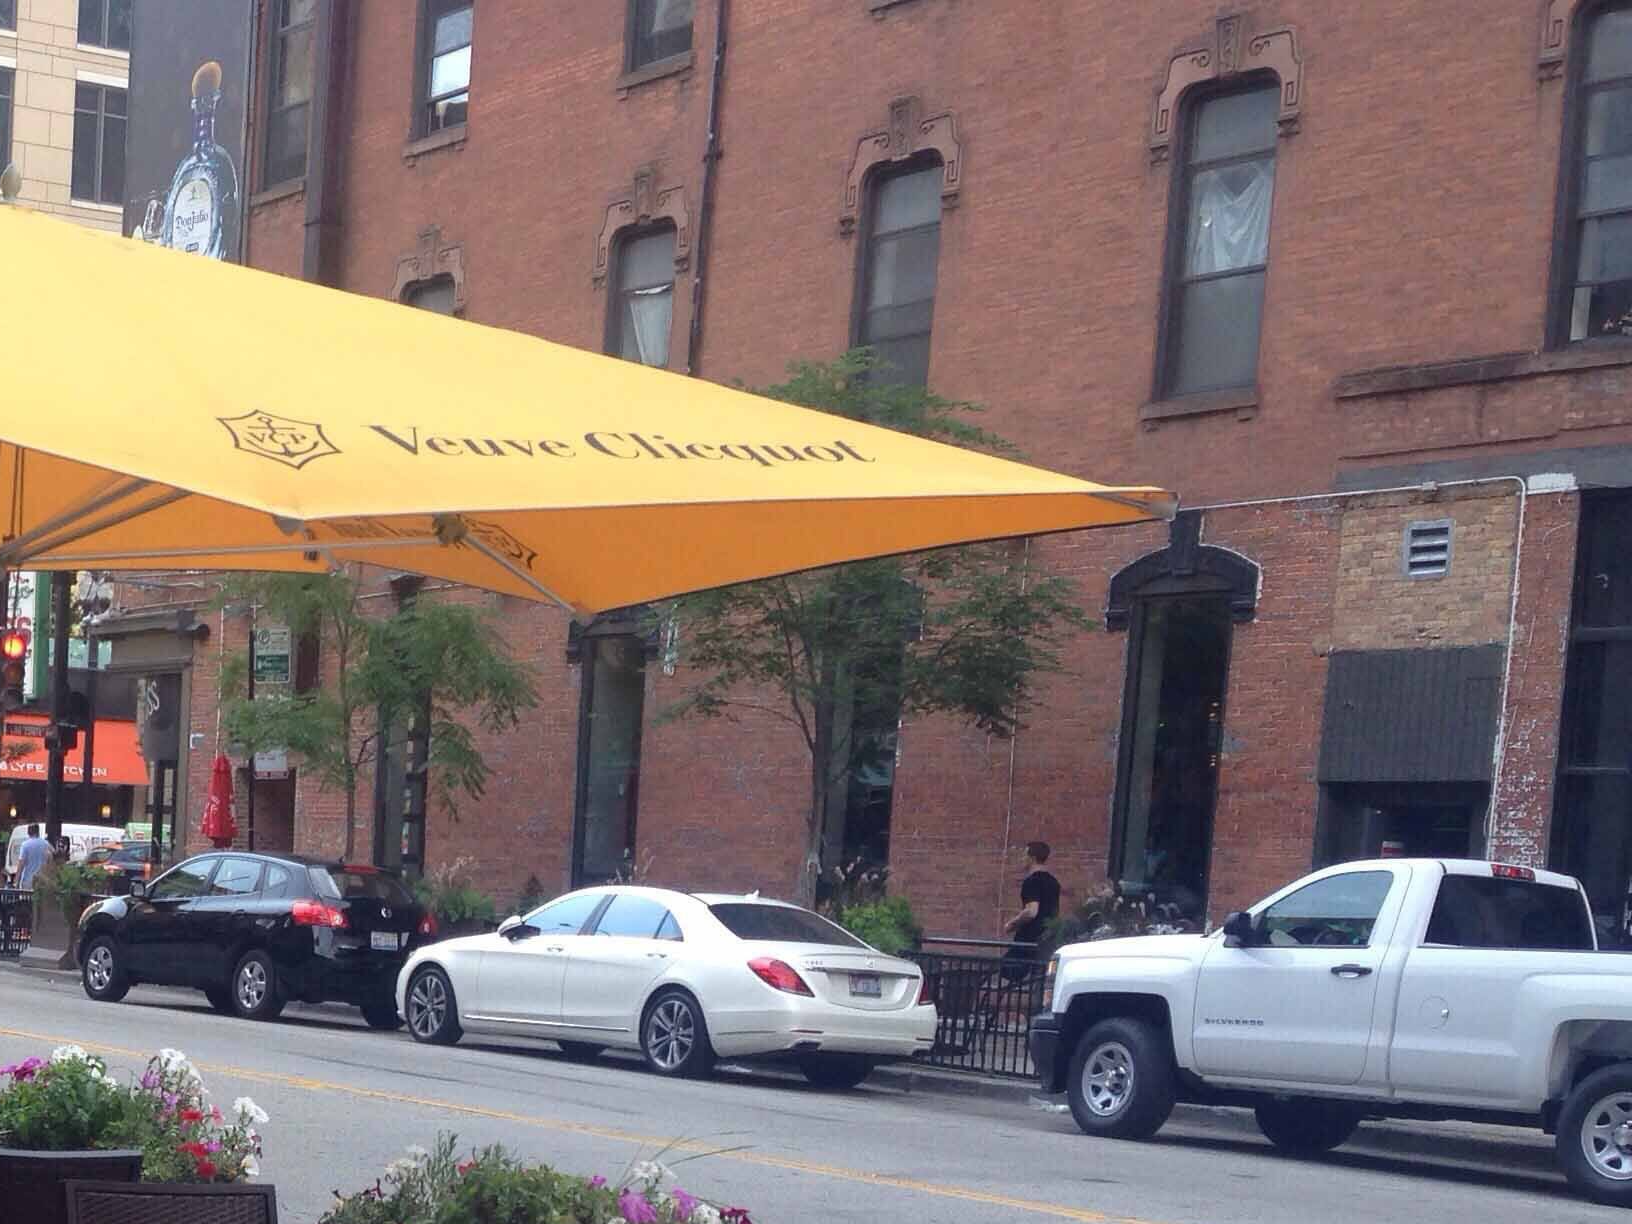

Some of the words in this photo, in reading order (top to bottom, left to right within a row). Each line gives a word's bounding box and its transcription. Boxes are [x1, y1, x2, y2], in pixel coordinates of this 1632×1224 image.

[362, 424, 577, 458] Veuve
[583, 431, 877, 467] Clicquot
[10, 761, 46, 773] LYFE
